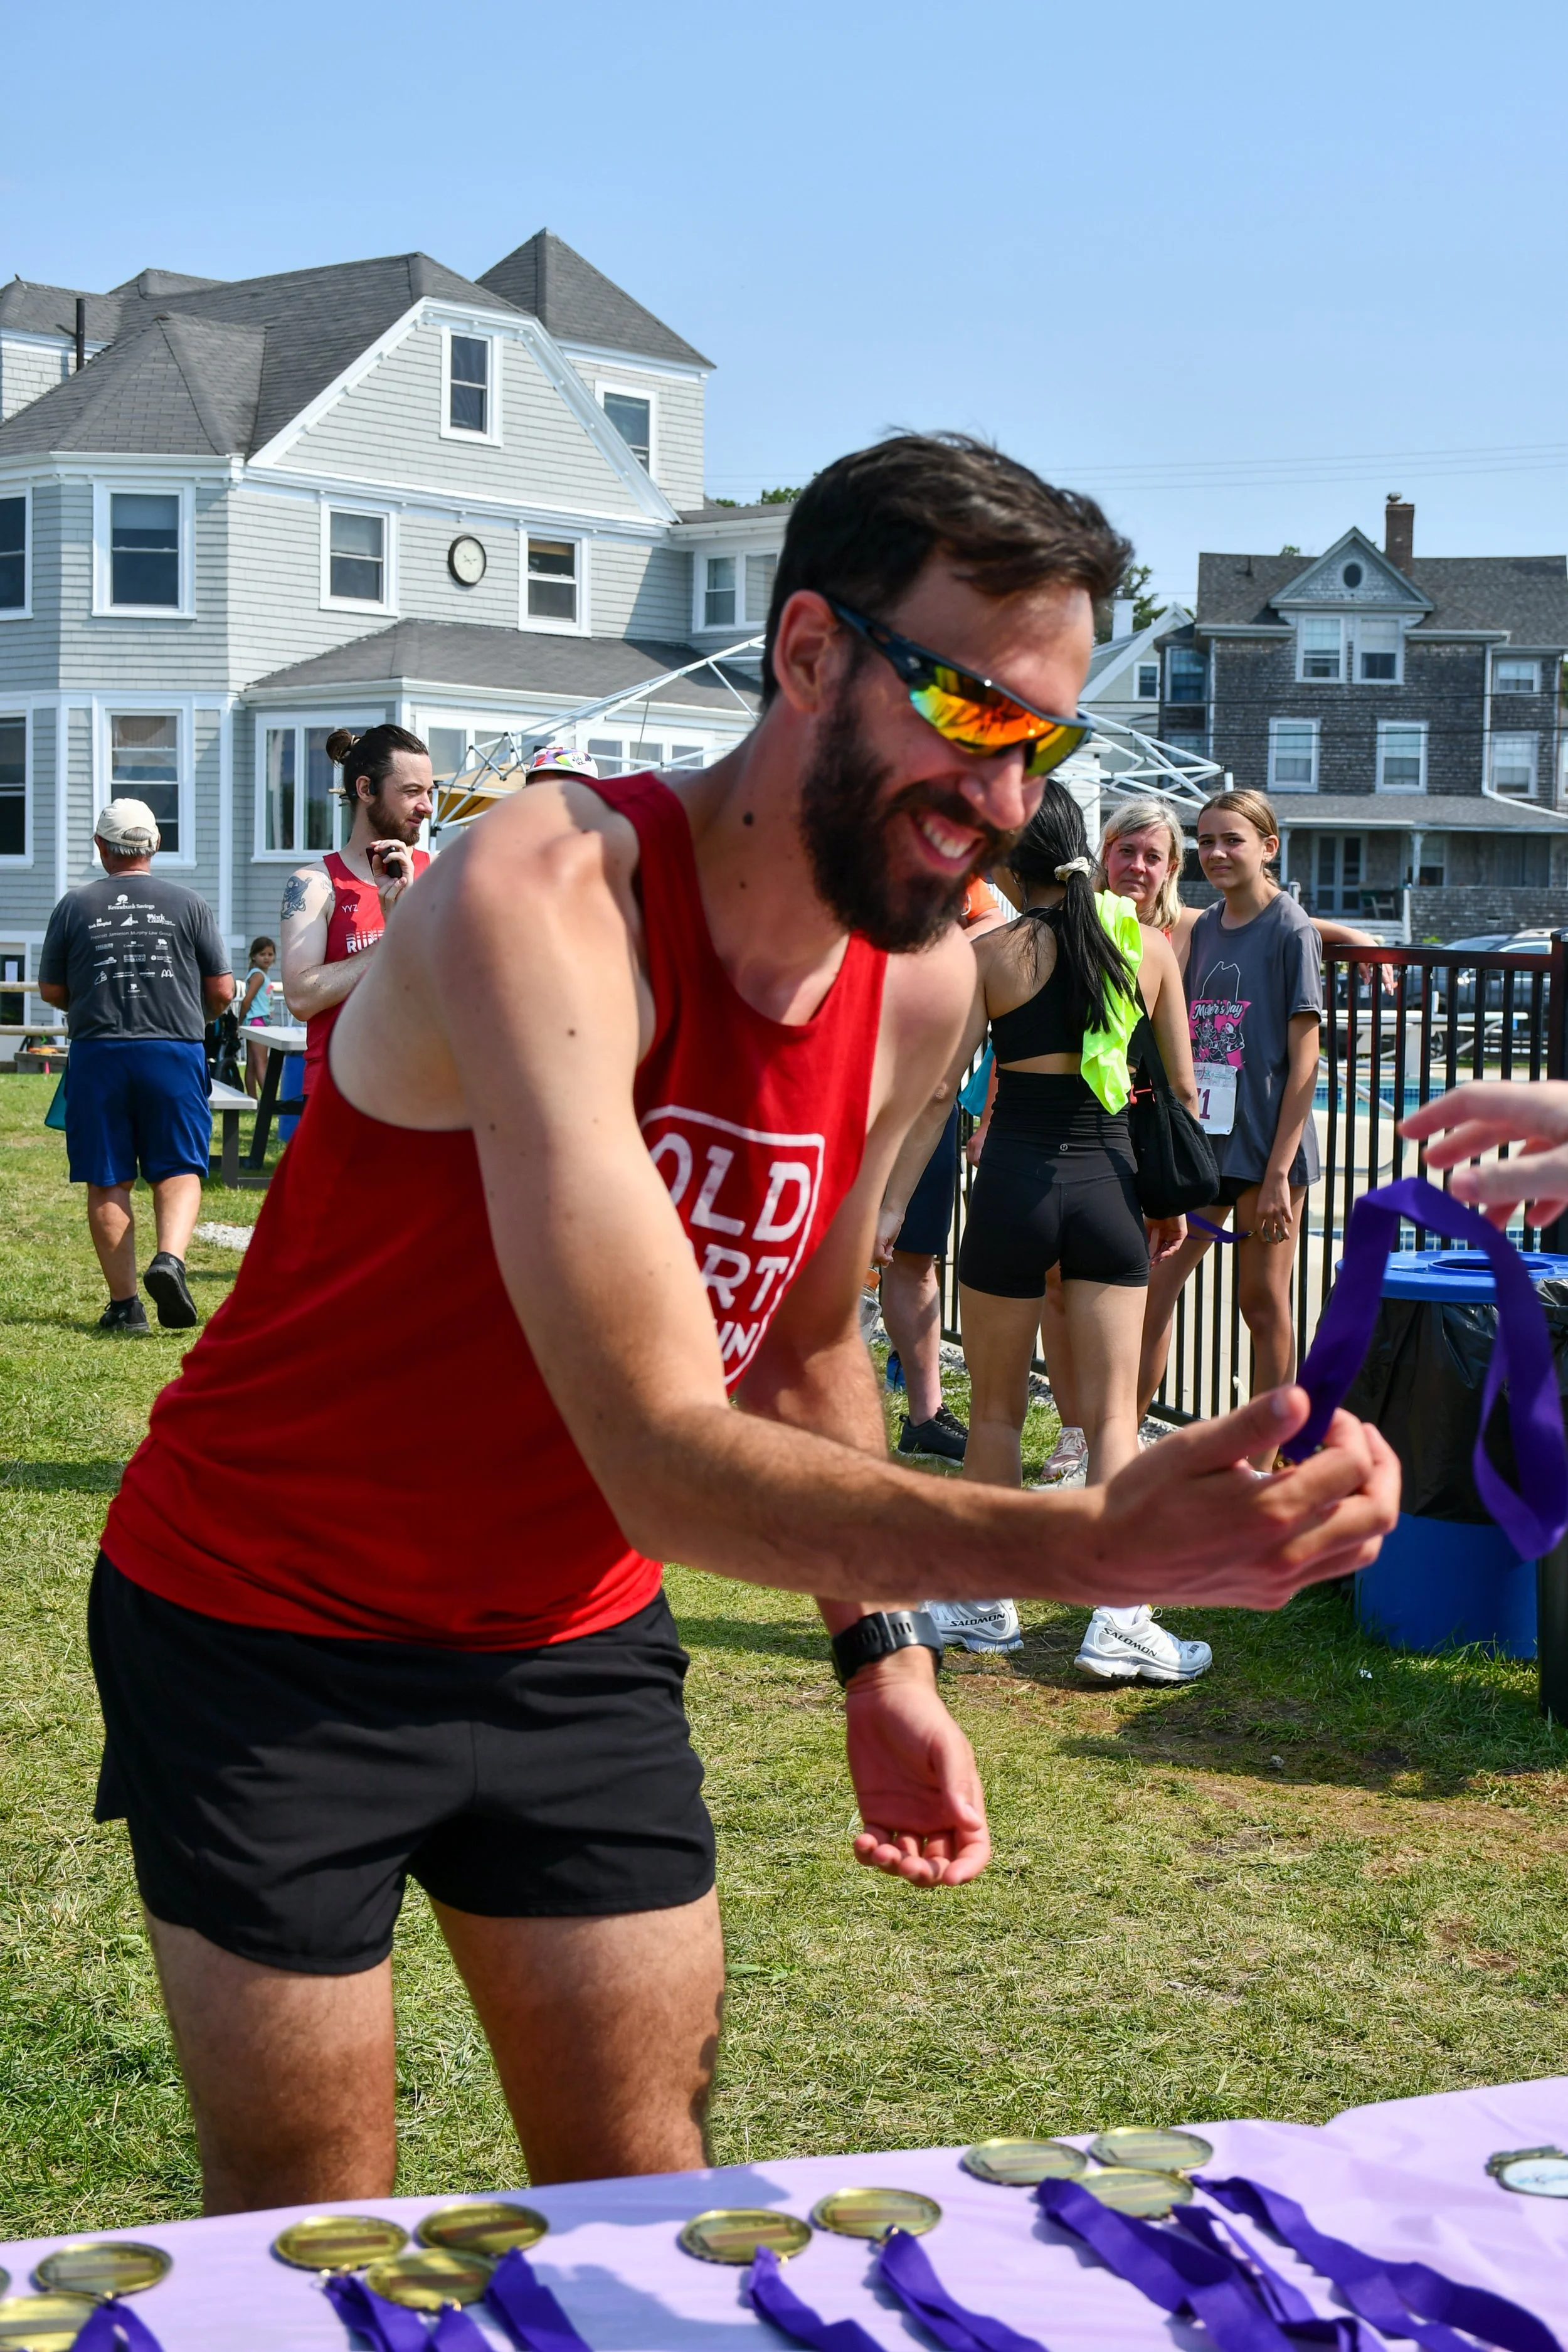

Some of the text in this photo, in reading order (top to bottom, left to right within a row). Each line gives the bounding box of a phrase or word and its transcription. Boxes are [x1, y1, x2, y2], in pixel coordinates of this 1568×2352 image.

[342, 904, 359, 913] YYZ
[687, 1238, 790, 1313] RT
[950, 1613, 1005, 1627] SALOMON
[1101, 1627, 1157, 1657] SALOMON
